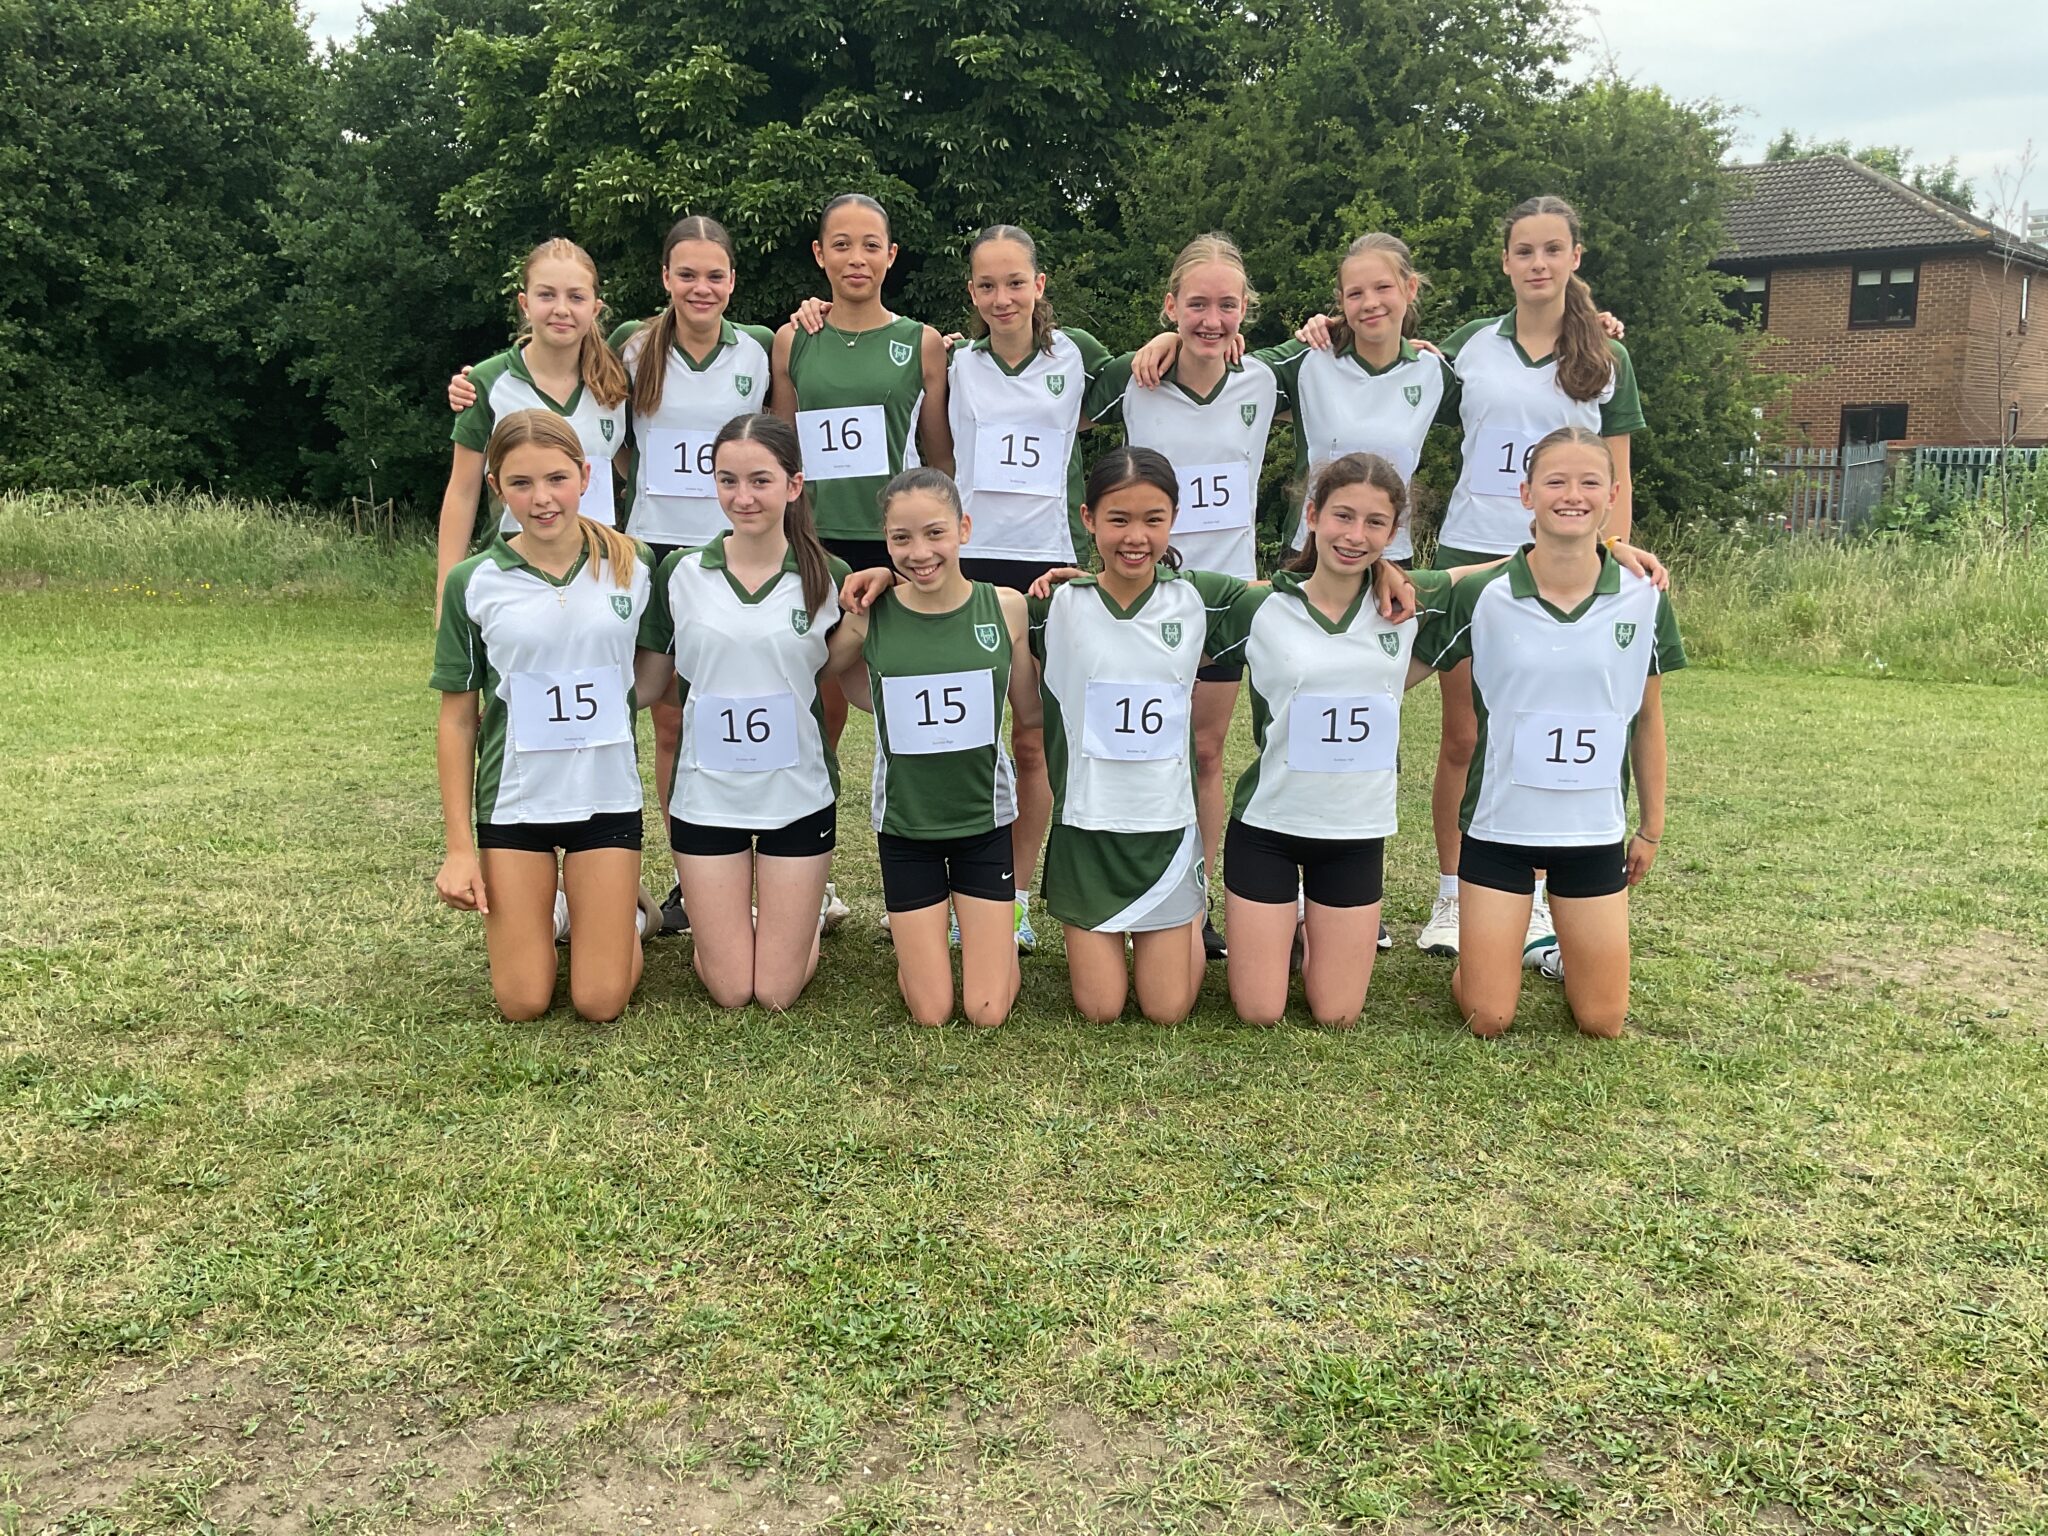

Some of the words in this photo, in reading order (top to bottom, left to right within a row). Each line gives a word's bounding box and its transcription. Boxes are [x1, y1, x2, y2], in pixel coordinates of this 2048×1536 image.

[819, 417, 862, 452] 16
[1000, 434, 1040, 468] 15
[674, 441, 716, 475] 16
[1190, 475, 1230, 509] 15
[546, 682, 598, 722] 15
[915, 686, 967, 726] 15
[1114, 697, 1163, 735] 16
[720, 707, 771, 743] 16
[1321, 706, 1370, 743] 15
[1545, 727, 1596, 764] 15
